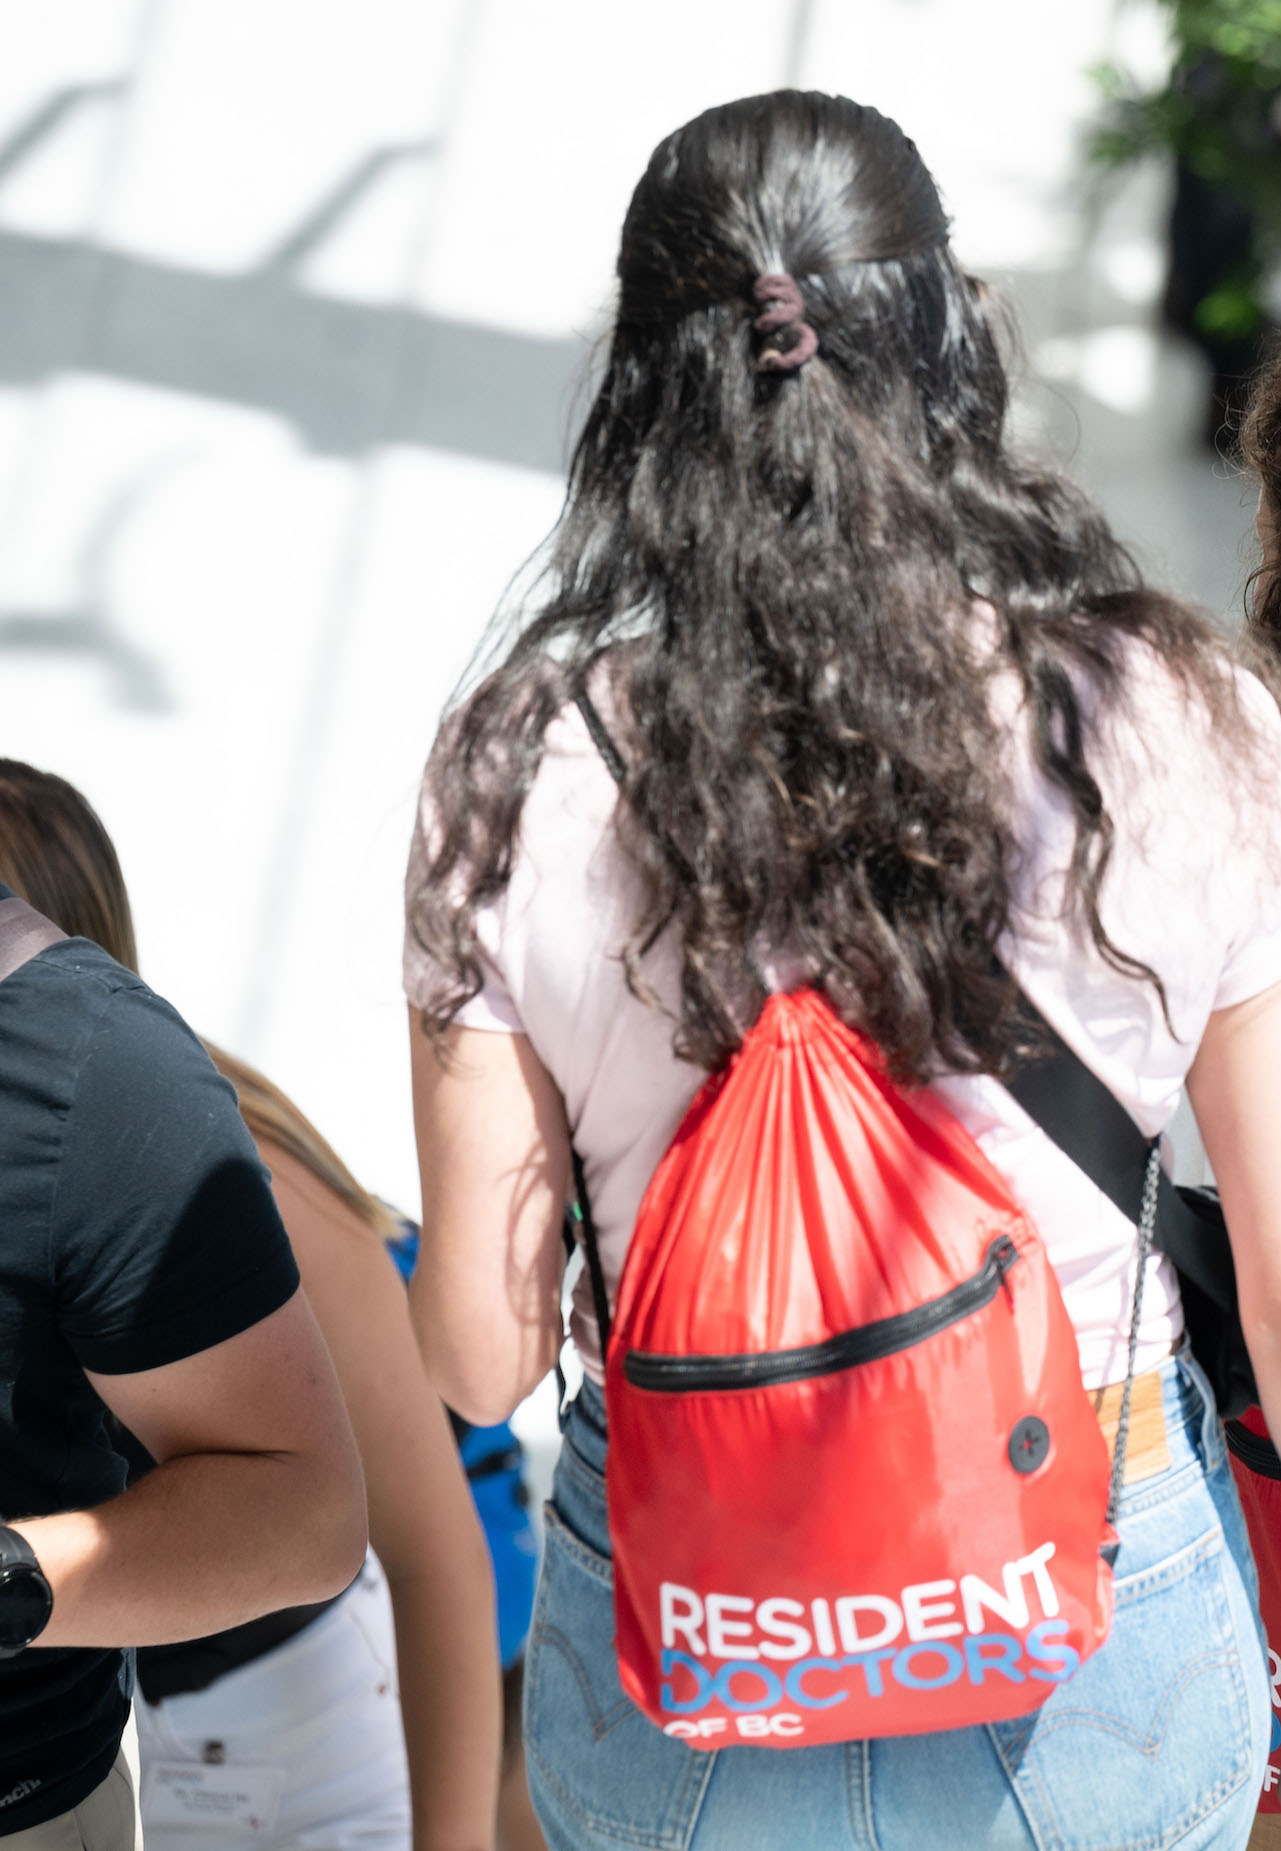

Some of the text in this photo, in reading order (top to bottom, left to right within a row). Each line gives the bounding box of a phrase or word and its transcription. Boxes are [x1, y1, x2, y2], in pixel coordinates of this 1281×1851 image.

[659, 1542, 1060, 1660] RESIDENT
[660, 1619, 1080, 1714] DOCTORS
[663, 1712, 805, 1738] OF BC
